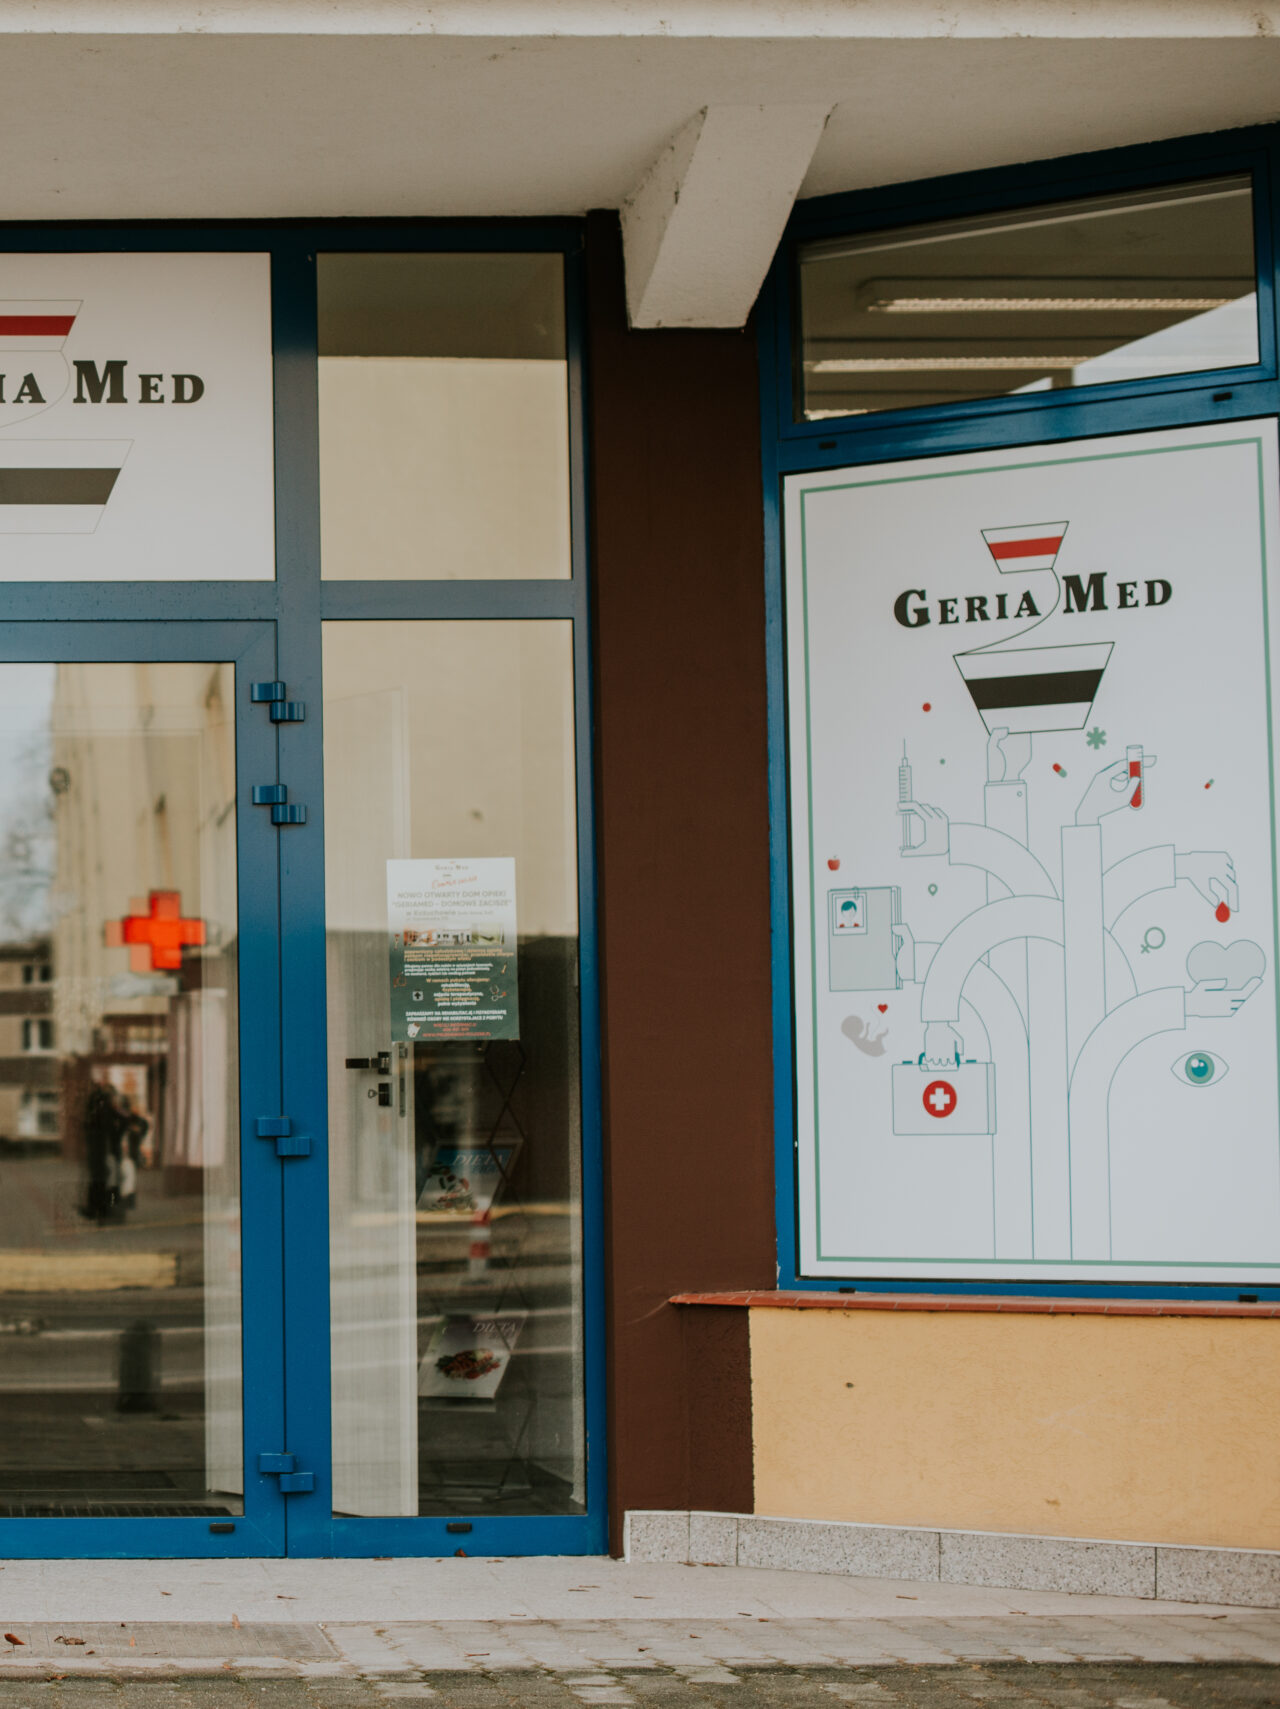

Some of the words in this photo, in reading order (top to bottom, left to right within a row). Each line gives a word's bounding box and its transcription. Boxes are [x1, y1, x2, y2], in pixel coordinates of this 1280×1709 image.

[72, 359, 206, 405] MED
[893, 588, 1041, 628] GERIA
[1061, 572, 1173, 615] MED
